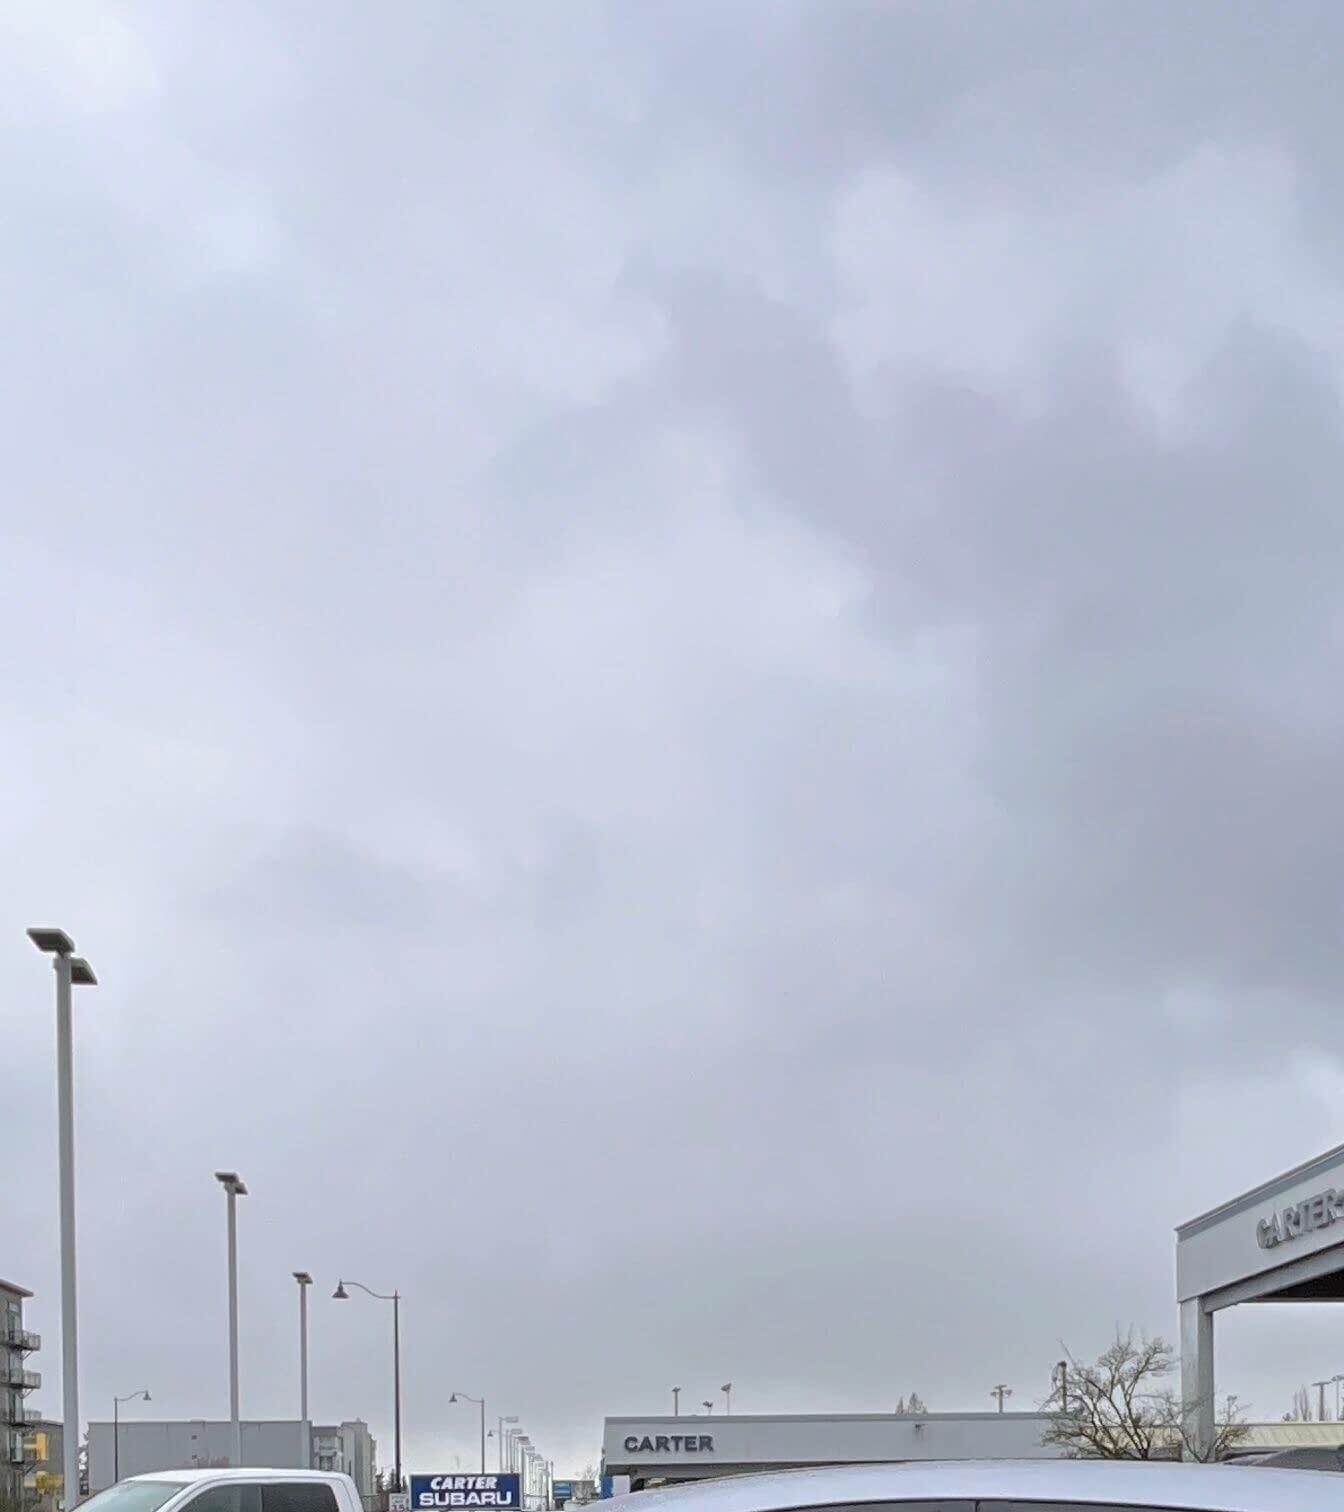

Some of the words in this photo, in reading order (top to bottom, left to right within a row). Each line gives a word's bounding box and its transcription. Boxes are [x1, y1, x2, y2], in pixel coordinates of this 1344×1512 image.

[623, 1435, 715, 1453] CARTER
[430, 1475, 498, 1490] CARTER
[418, 1491, 513, 1507] SUBARU
